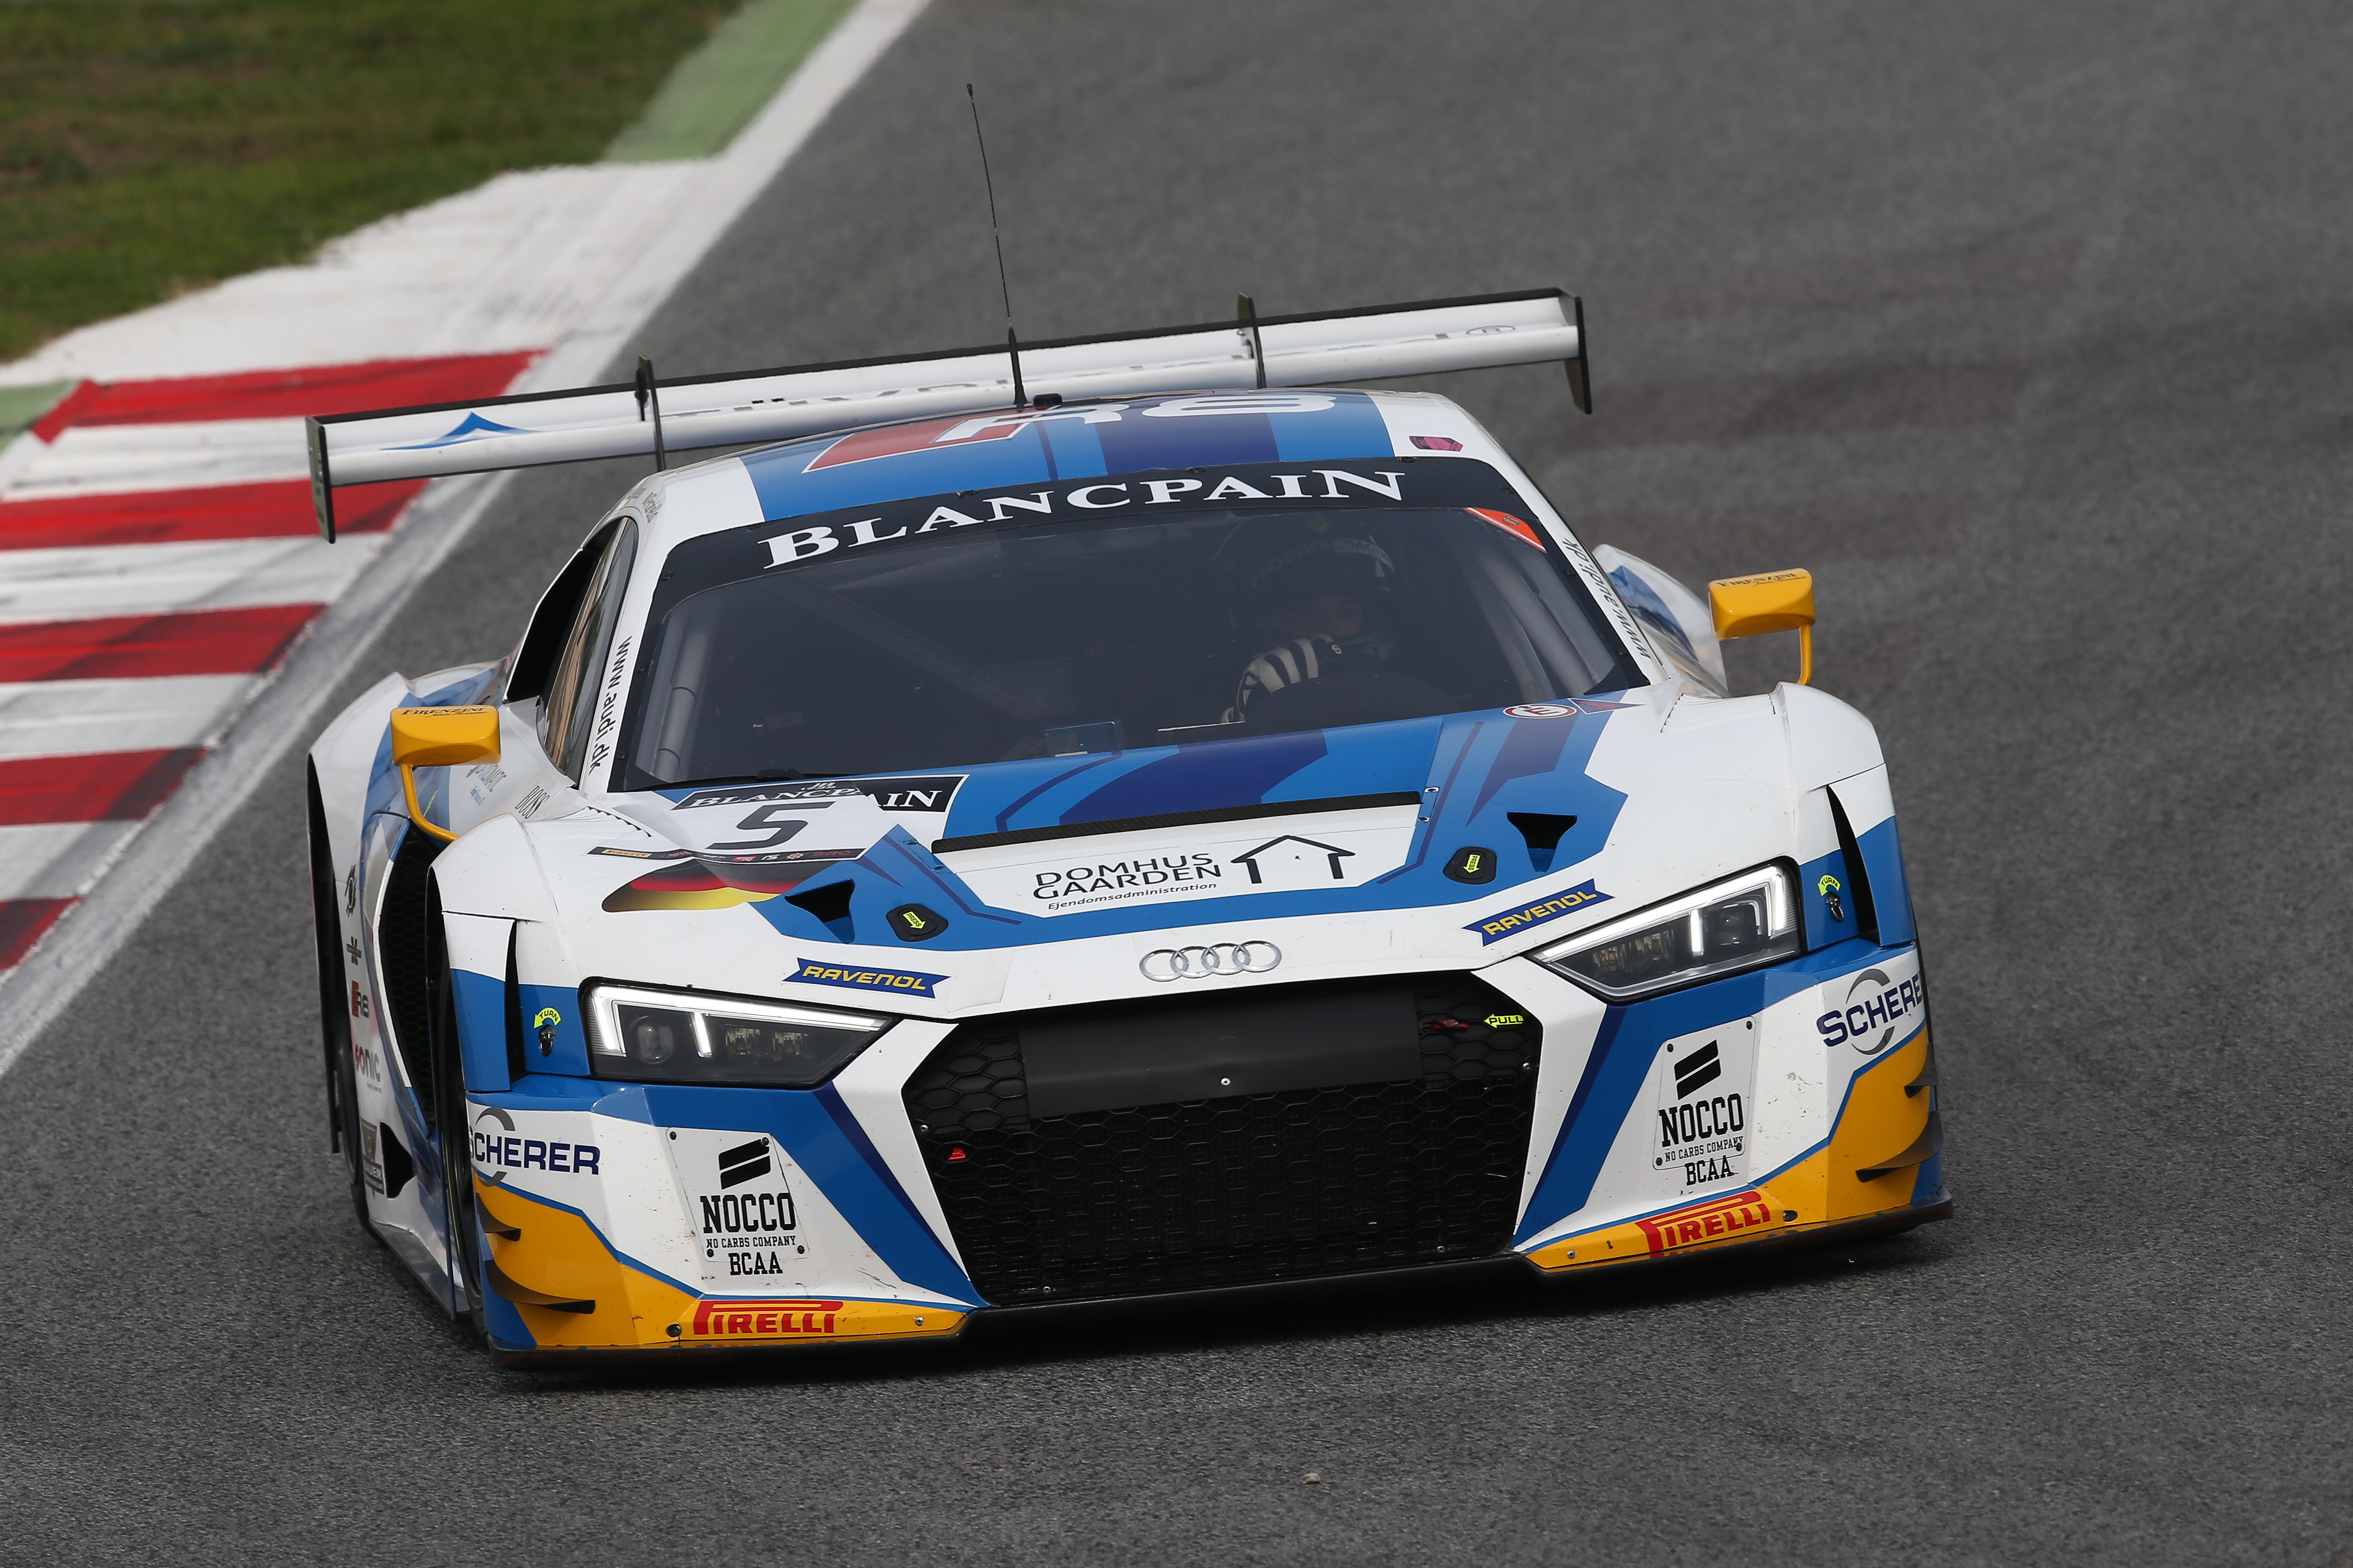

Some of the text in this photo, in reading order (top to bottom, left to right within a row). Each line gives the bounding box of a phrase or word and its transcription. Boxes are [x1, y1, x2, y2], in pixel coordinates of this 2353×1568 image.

[757, 469, 1405, 570] BLANCPAIN
[1561, 537, 1651, 660] www.audi.dk
[588, 635, 632, 776] www.audi.dk
[514, 785, 550, 819] BOSS
[685, 787, 943, 808] BLANCPAIN
[704, 801, 837, 850] 5
[1035, 852, 1213, 886] DOMHUS
[1468, 856, 1478, 870] PRESS
[1032, 864, 1222, 900] GAARDEN
[1048, 882, 1217, 911] Ejendomsadministration
[1821, 877, 1838, 887] TURN
[906, 913, 922, 927] PRESS
[1482, 890, 1598, 936] RAVENOL
[801, 964, 927, 990] RAVENOL
[539, 1010, 559, 1022] TURN
[1488, 1015, 1523, 1024] PULL
[1816, 973, 1923, 1047] SCHERE
[1658, 1093, 1744, 1148] NOCCO
[1665, 1136, 1744, 1162] NO CARBS COMPANY
[1685, 1155, 1733, 1186] BCAA
[699, 1192, 797, 1234] NOCCO
[1635, 1191, 1771, 1253] PIRELLI
[706, 1235, 796, 1248] NO CARBS COMPANY
[728, 1251, 783, 1276] BCAA
[693, 1300, 844, 1335] PIRELLI
